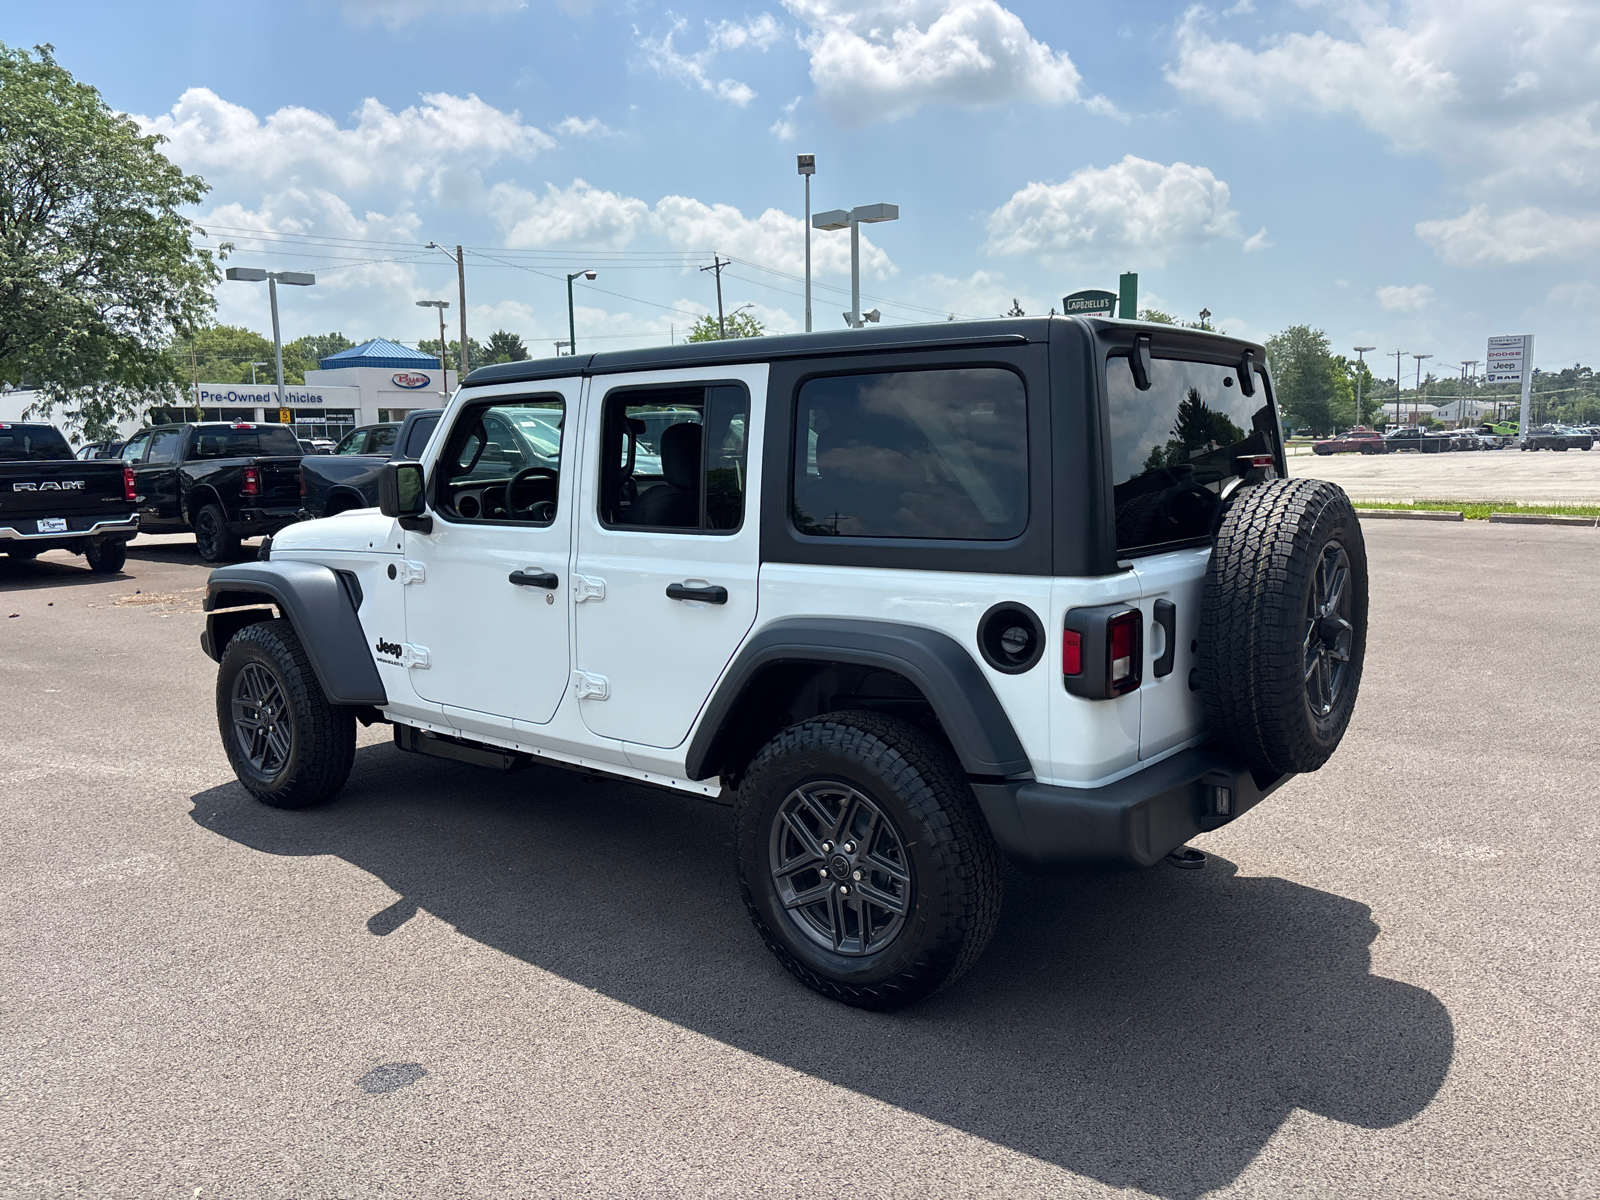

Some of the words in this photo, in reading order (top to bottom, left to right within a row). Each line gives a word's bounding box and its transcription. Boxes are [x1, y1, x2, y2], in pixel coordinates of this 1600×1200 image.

[1493, 362, 1516, 370] Jeep
[200, 391, 270, 402] Pre-Owned
[282, 411, 288, 419] 5
[13, 480, 86, 492] RAM
[376, 637, 402, 659] Jeep
